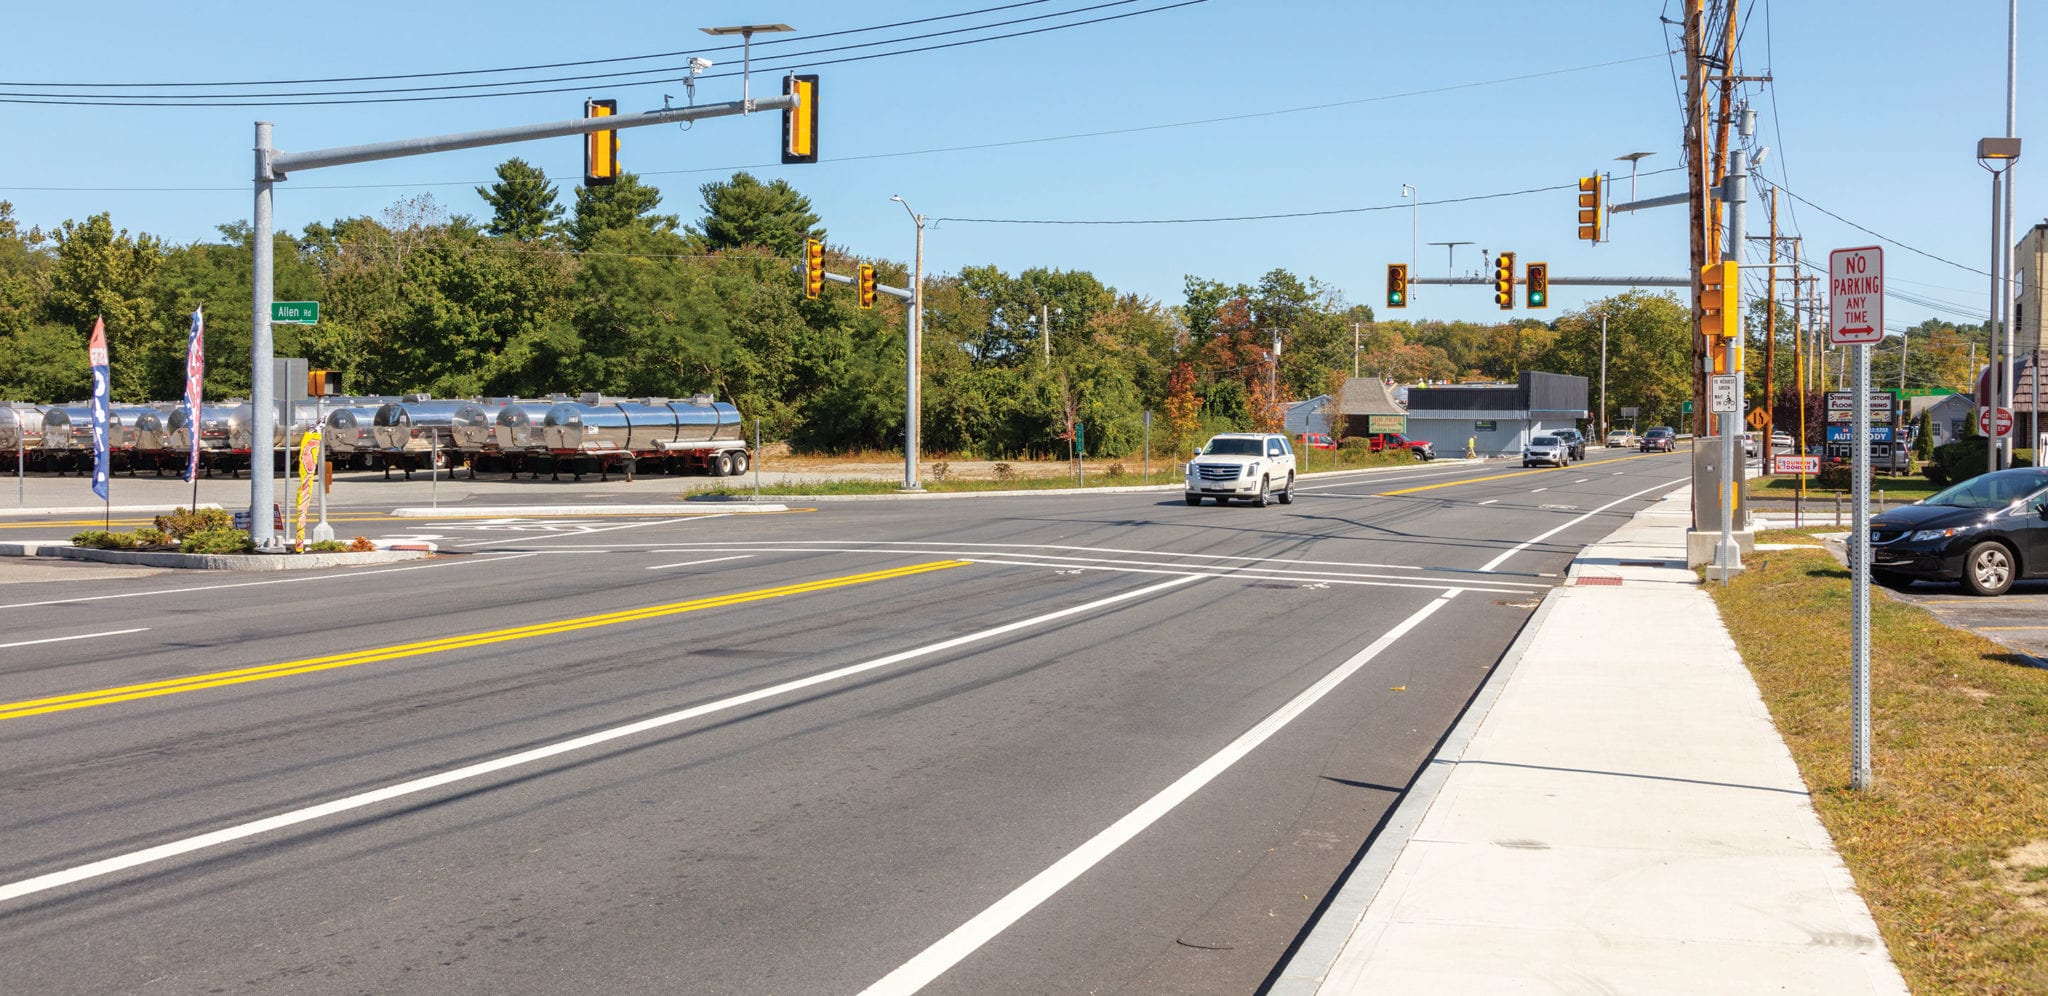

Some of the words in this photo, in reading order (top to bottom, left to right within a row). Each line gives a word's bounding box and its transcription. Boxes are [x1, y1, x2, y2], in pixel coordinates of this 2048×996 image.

[1846, 256, 1866, 274] NO
[1833, 276, 1879, 296] PARKING
[1846, 297, 1866, 309] ANY
[278, 306, 299, 317] Allen
[303, 309, 312, 317] Rd
[1845, 311, 1868, 323] TIME
[1830, 445, 1889, 457] TAOO
